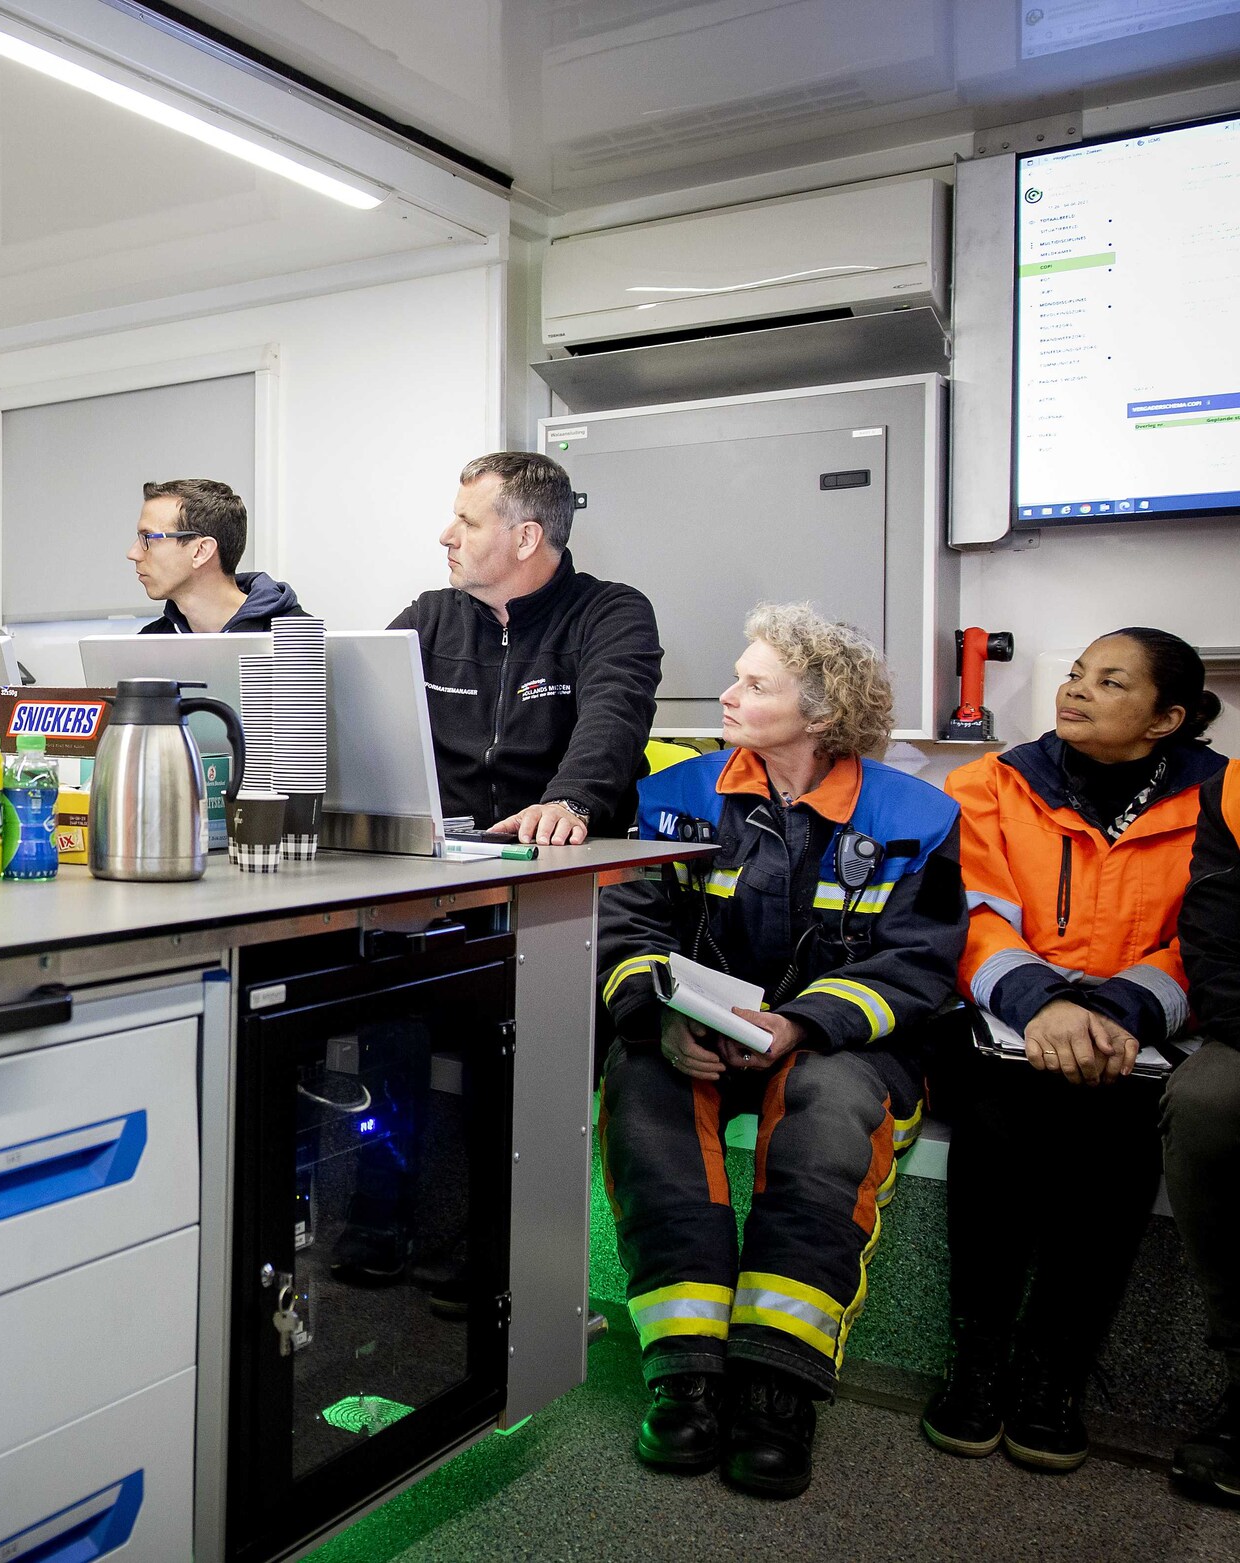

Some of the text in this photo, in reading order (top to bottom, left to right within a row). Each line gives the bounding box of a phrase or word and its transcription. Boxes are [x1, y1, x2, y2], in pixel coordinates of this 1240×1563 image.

[1132, 402, 1187, 413] VERGADERSCHEMA
[424, 681, 478, 696] FORMATIEMANAGER
[12, 706, 99, 734] SNICKERS
